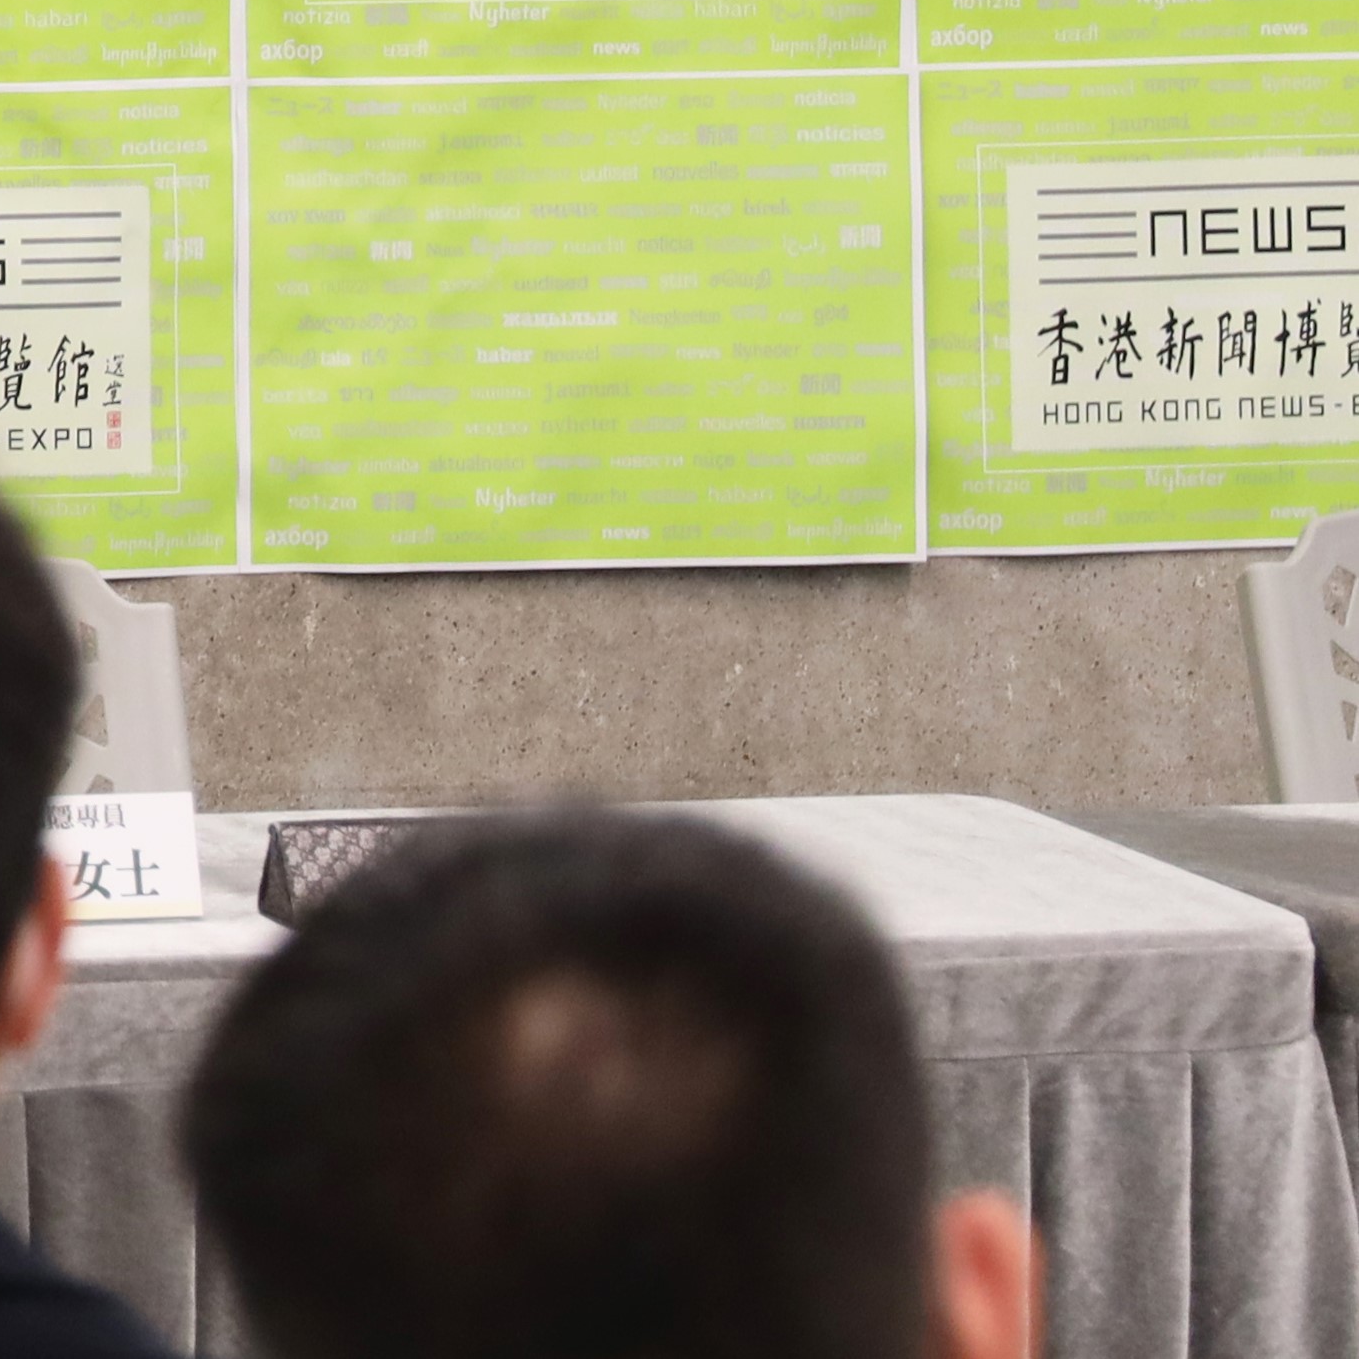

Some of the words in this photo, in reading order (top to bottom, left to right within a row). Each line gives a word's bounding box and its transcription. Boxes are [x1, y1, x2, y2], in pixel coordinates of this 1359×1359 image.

[469, 1, 550, 26] Nyheter
[1260, 22, 1309, 36] news
[593, 39, 640, 56] news
[1043, 401, 1123, 424] HONG
[1141, 398, 1221, 422] KONG
[602, 526, 651, 540] news
[66, 849, 159, 901] 女士
